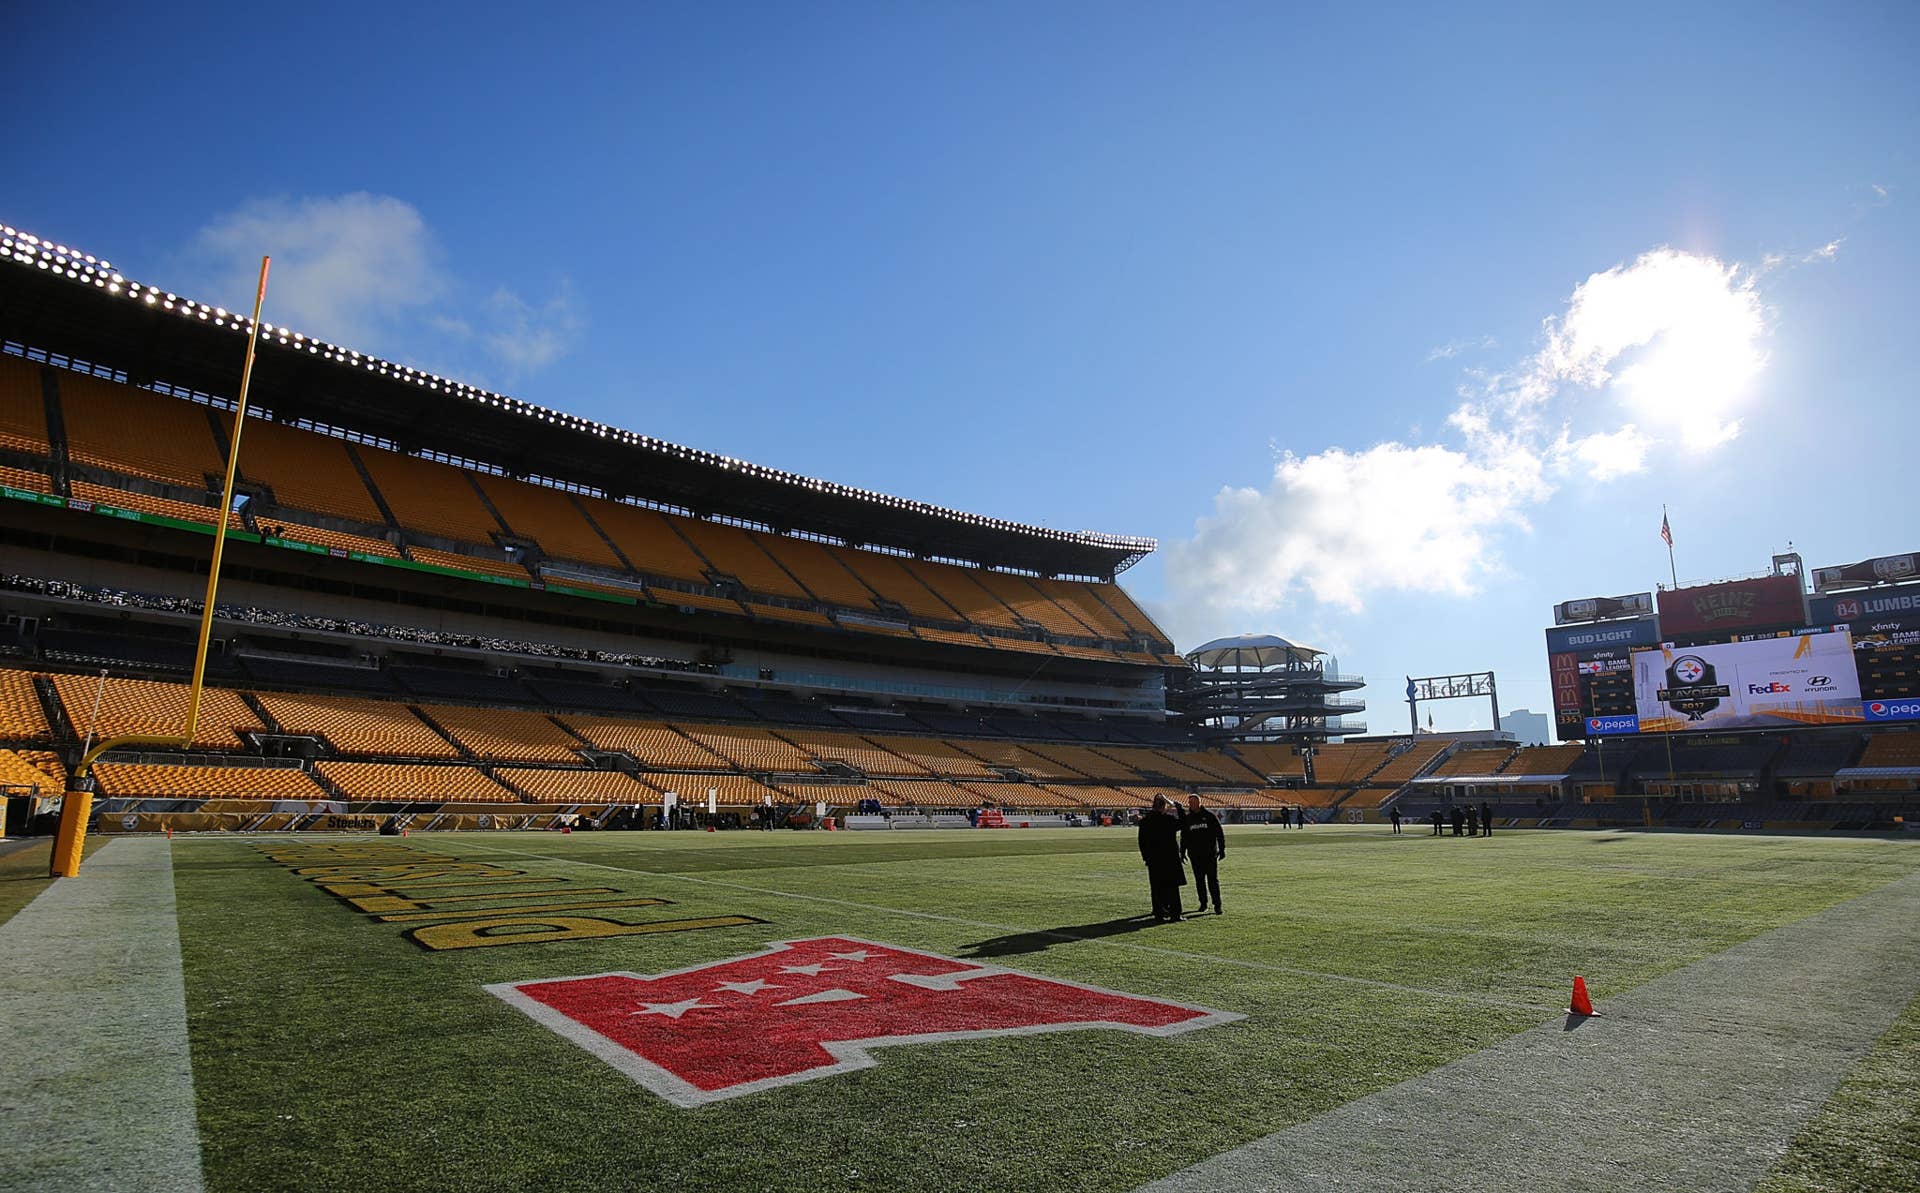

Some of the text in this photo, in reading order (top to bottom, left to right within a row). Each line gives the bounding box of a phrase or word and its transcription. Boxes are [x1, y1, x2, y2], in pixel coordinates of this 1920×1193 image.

[1693, 591, 1755, 613] HEINZ
[1838, 602, 1858, 616] 84
[1872, 622, 1900, 631] xfinity
[1568, 630, 1632, 645] BUD LIGHT
[1593, 652, 1615, 660] xfinity
[1660, 686, 1728, 699] PLAYOFFS
[1748, 681, 1790, 695] FedEx
[1682, 702, 1705, 710] 2017
[1604, 718, 1635, 730] pepsi
[328, 815, 376, 829] Steelers
